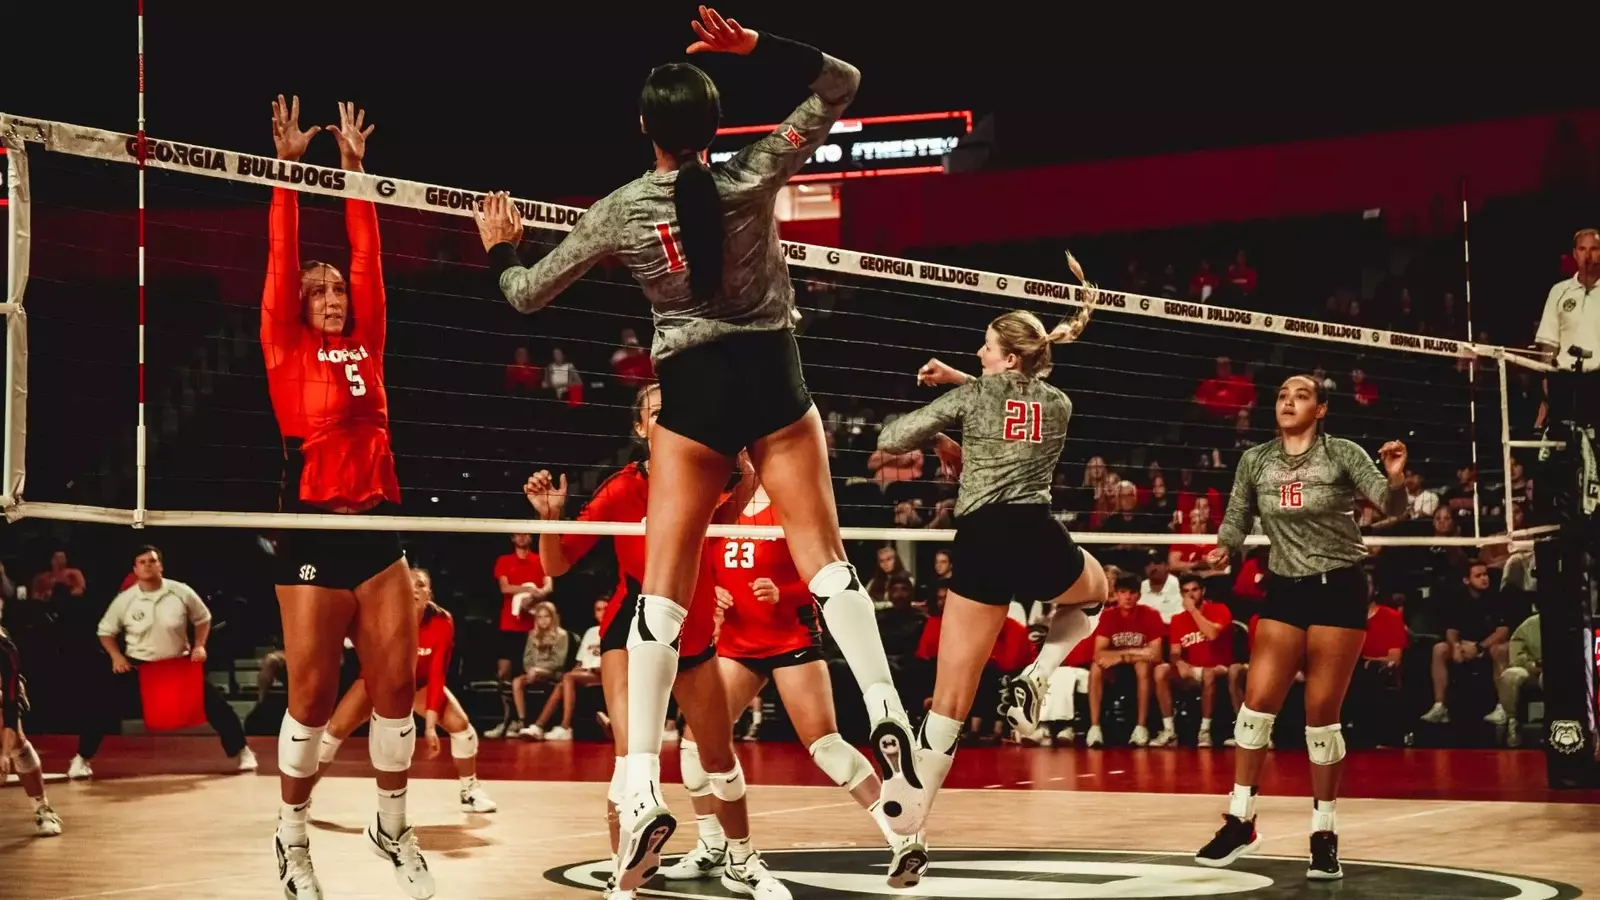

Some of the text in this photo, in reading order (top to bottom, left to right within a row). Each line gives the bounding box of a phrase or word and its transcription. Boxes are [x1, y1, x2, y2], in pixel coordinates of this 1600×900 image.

[237, 155, 346, 190] BULLDOGS
[376, 180, 396, 197] G
[425, 187, 486, 212] GEORG
[513, 200, 585, 226] BULLDO
[826, 250, 840, 264] G
[860, 256, 914, 277] GEORGIA
[920, 265, 980, 286] BULLDOGS
[997, 277, 1007, 290] G
[1024, 281, 1070, 300] GEORGIA
[1075, 288, 1126, 308] BDOGS
[1140, 299, 1149, 310] G
[1164, 301, 1203, 318] GEORGIA
[1207, 308, 1251, 324] BULLDOGS
[1264, 316, 1273, 327] G
[1284, 319, 1319, 334] GEORGIA
[1323, 324, 1361, 340] BULLDOGS
[1372, 332, 1380, 342] G
[1390, 334, 1421, 348] GEORGIA
[1424, 338, 1458, 353] BULLDOGS
[345, 363, 367, 397] 5
[1003, 398, 1043, 443] 21
[1280, 481, 1304, 508] 16
[724, 541, 755, 569] 23
[299, 564, 317, 581] SEC
